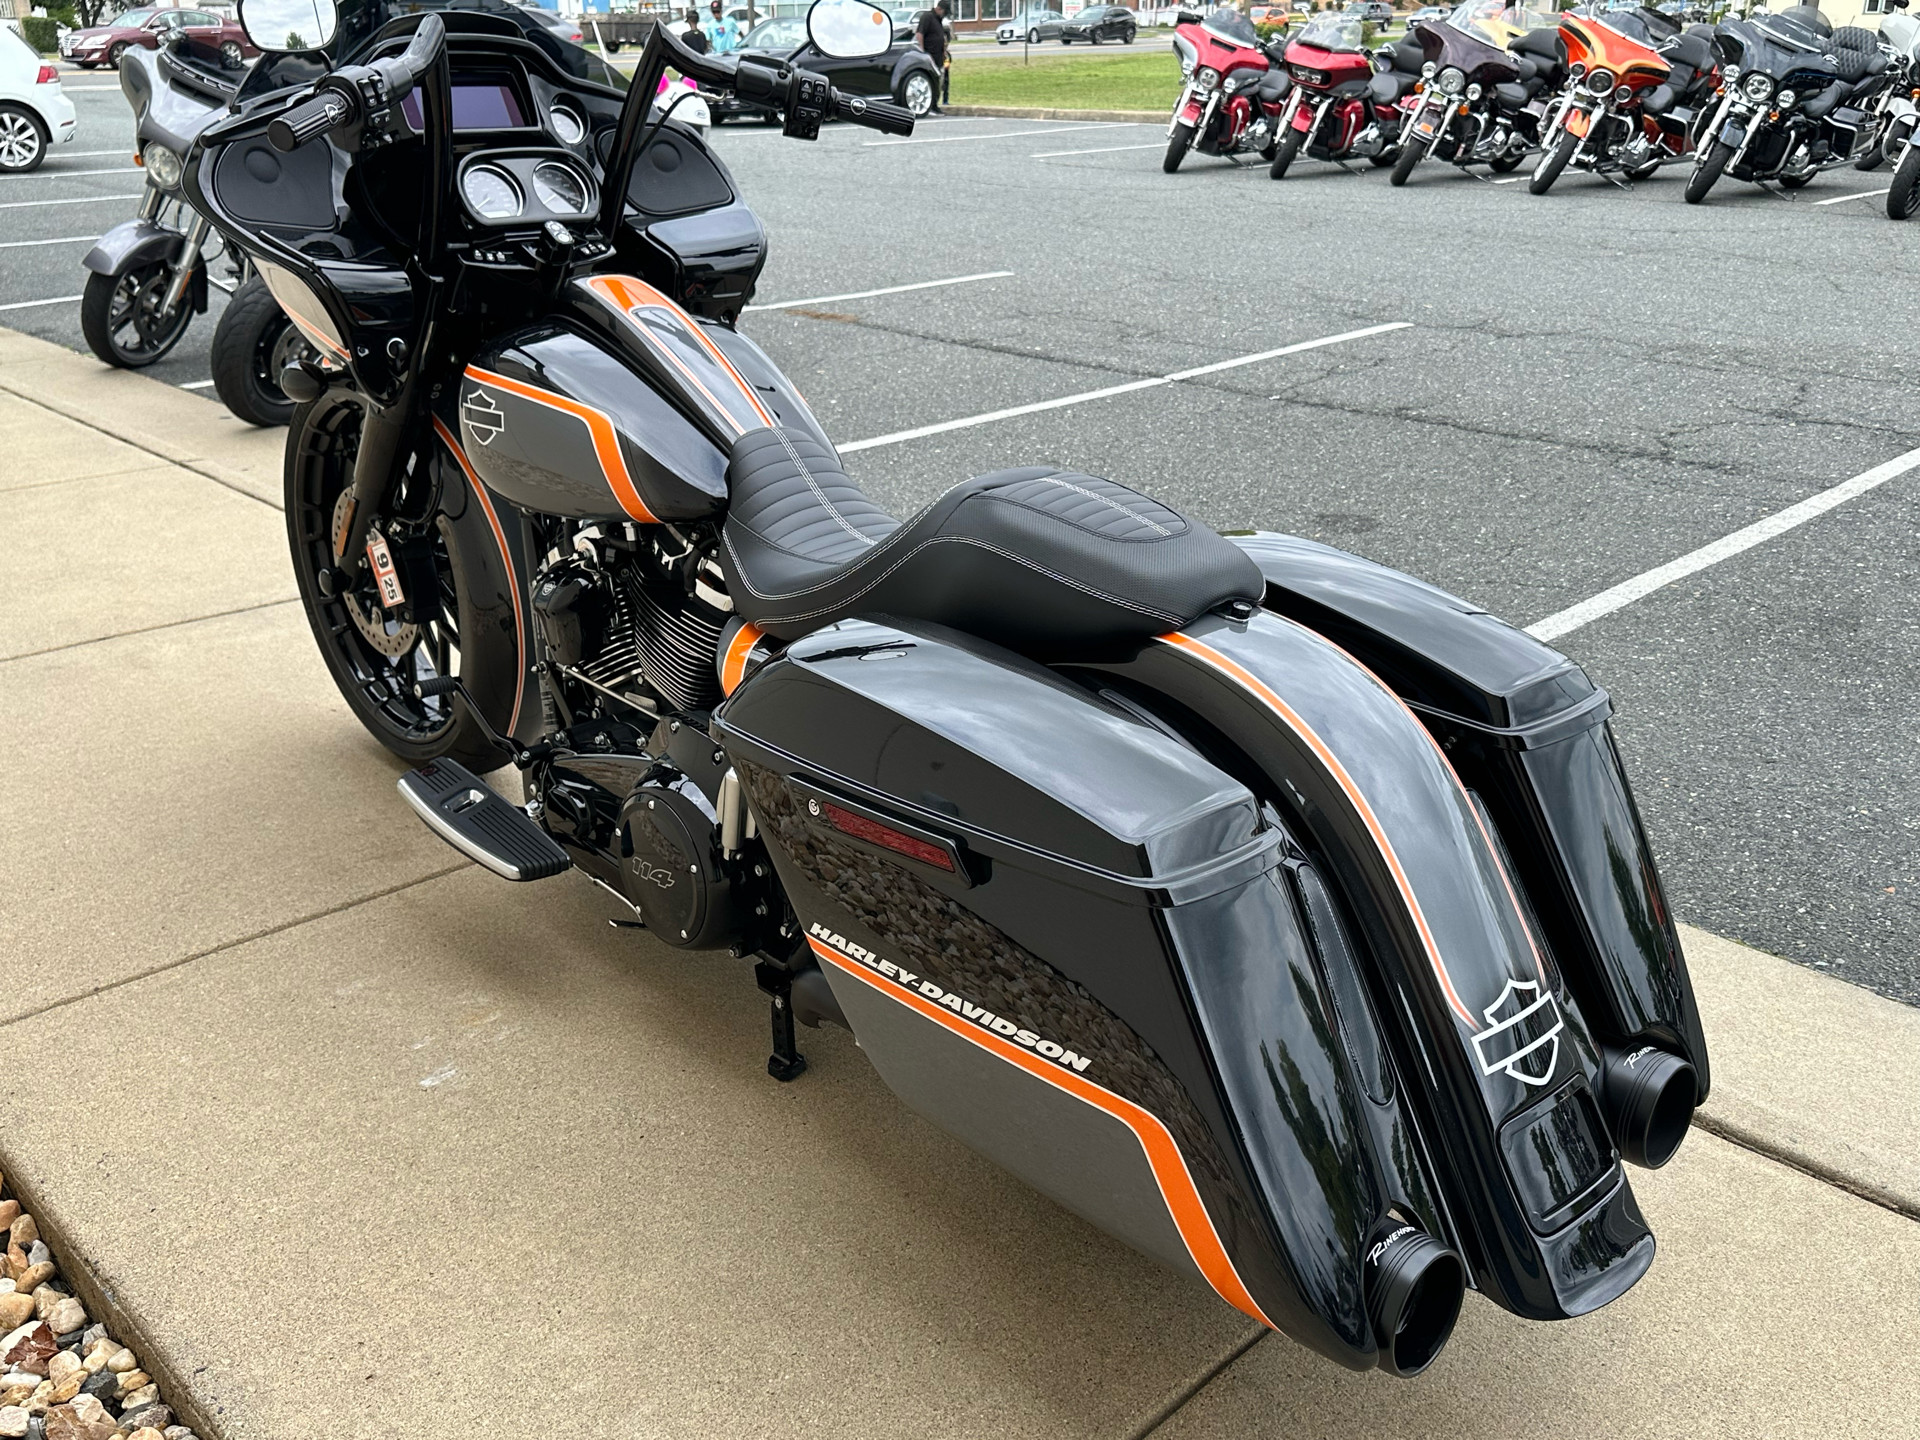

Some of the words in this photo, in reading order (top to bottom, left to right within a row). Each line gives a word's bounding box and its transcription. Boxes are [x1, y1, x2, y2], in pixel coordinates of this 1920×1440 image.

[376, 552, 390, 569] 9
[384, 577, 398, 600] 25
[632, 856, 675, 889] 114
[810, 922, 1092, 1072] HARLEY-DAVIDSON
